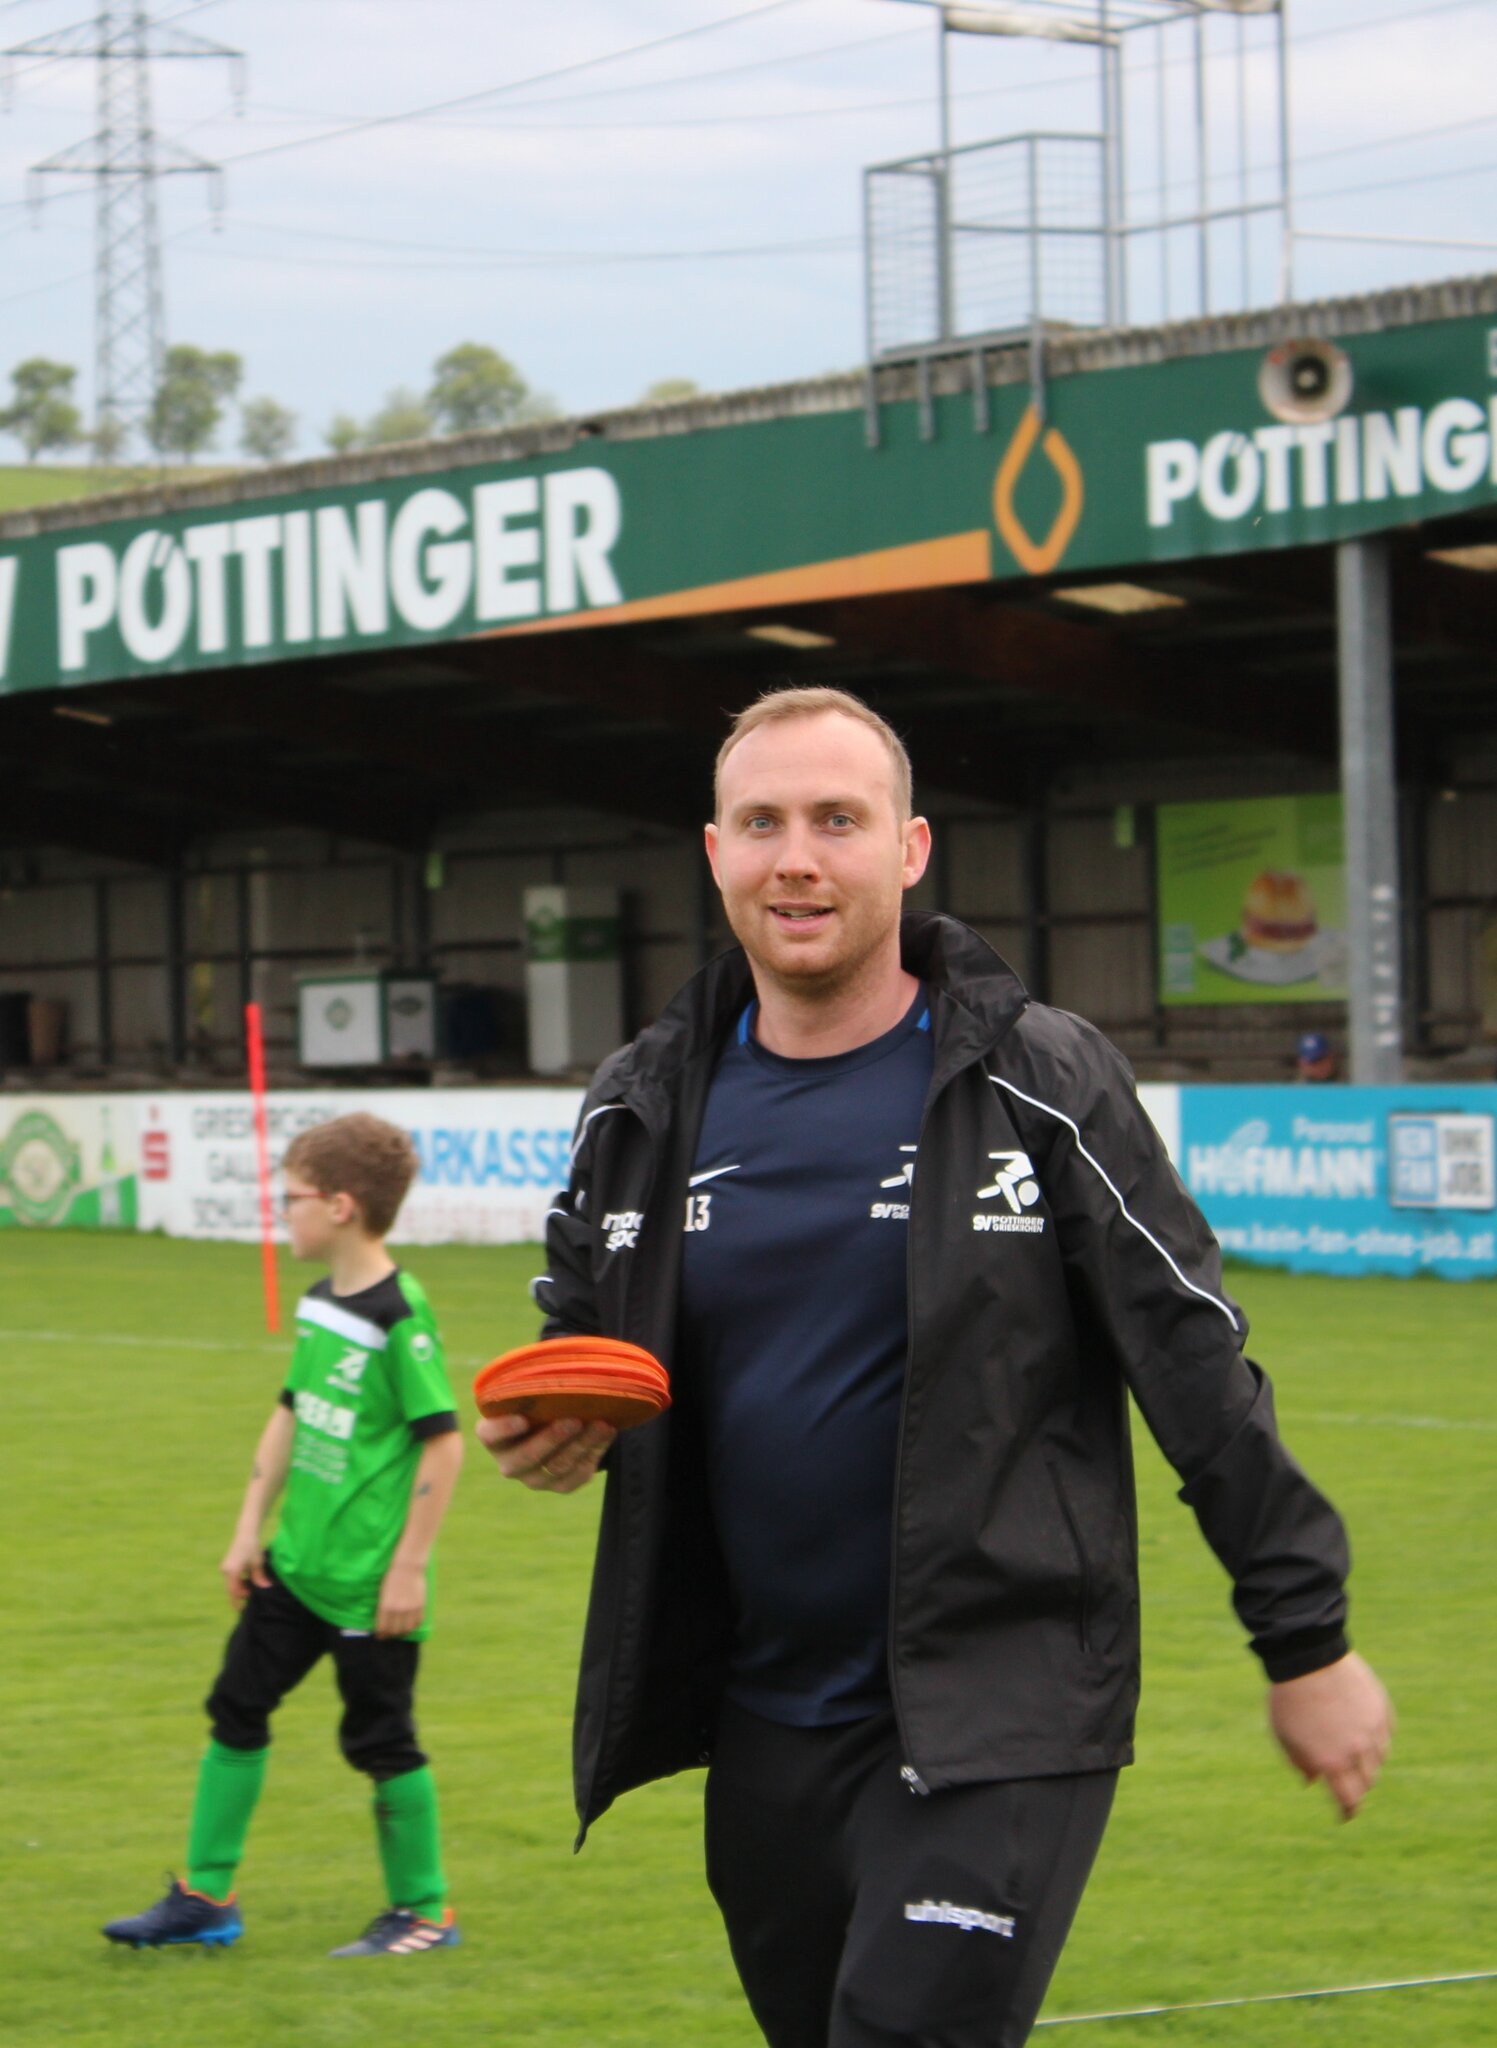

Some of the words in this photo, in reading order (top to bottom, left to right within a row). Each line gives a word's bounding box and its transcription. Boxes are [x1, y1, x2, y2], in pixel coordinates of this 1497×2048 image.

[1146, 397, 1497, 527] PÖTTING
[683, 1195, 712, 1232] 13
[973, 1215, 993, 1231] SV
